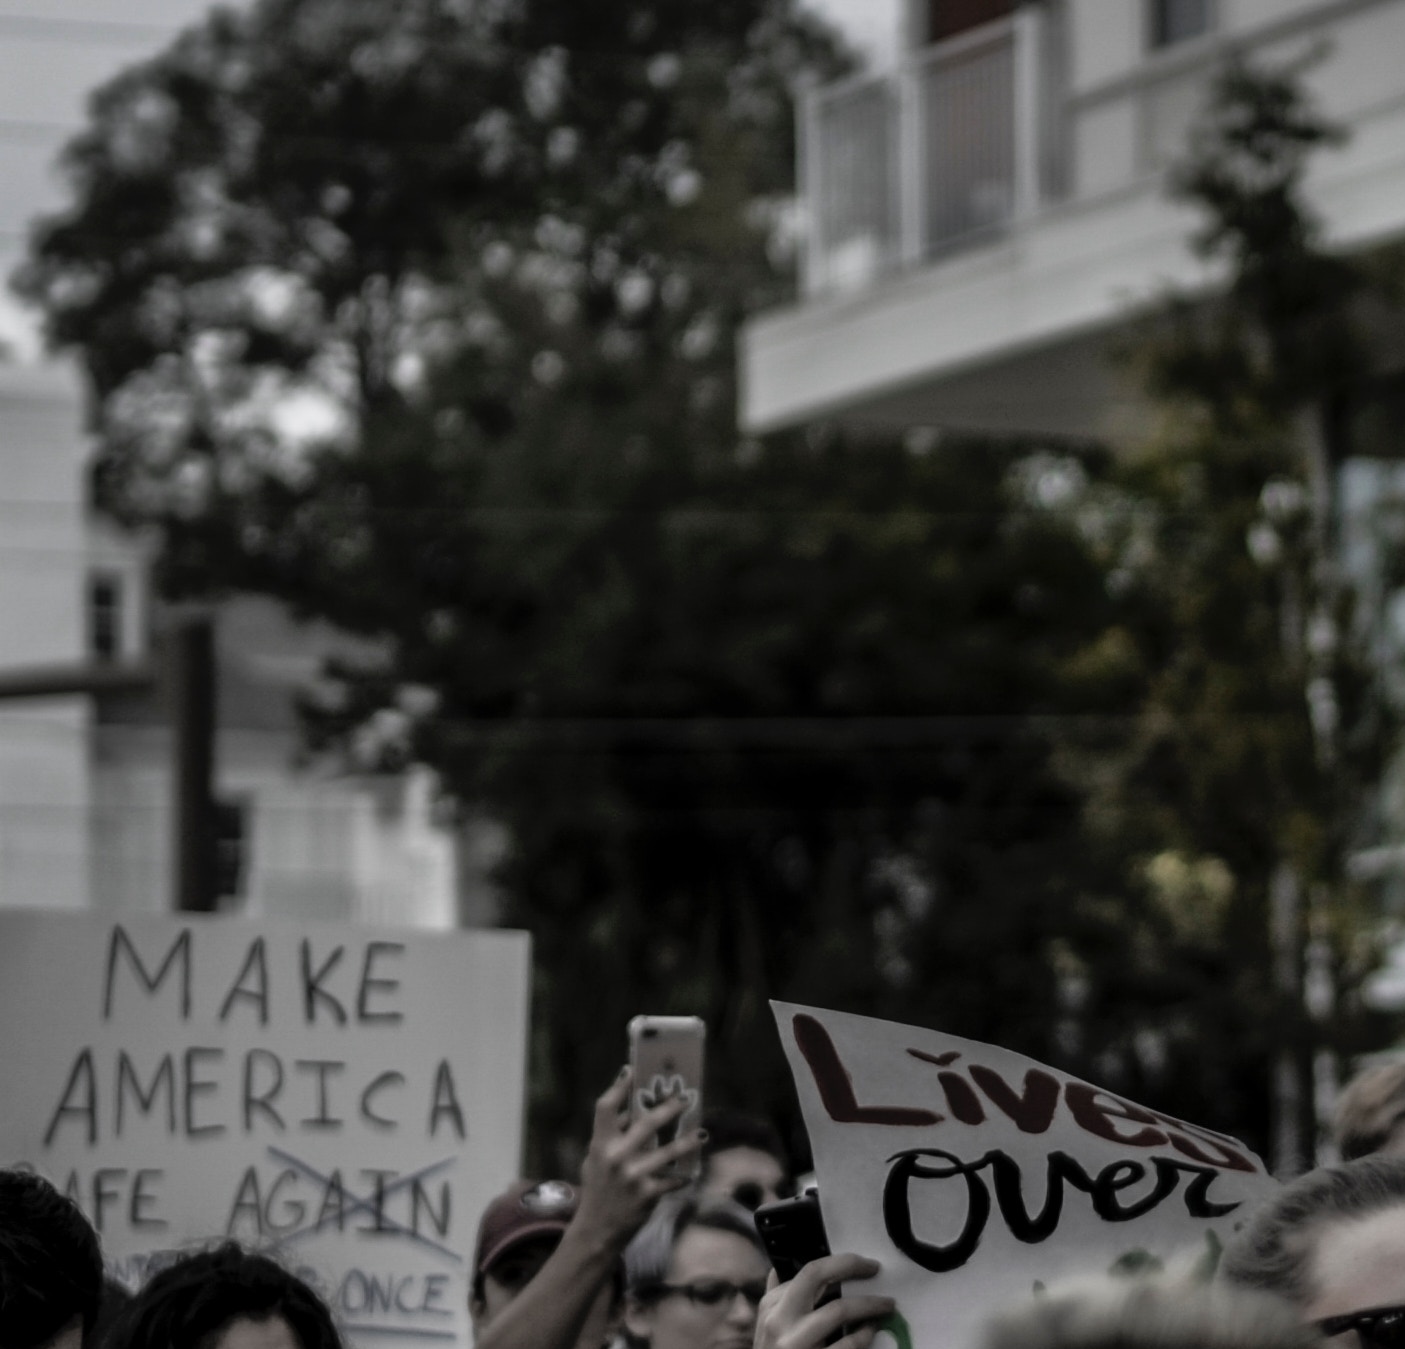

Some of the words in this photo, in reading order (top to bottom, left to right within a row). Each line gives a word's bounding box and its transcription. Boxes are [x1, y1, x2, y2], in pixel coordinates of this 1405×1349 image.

[103, 922, 406, 1027] MAKE
[43, 1045, 467, 1147] AMERICA
[12, 1160, 169, 1233] FE
[226, 1164, 452, 1239] AGAIN
[343, 1267, 457, 1316] ONCE
